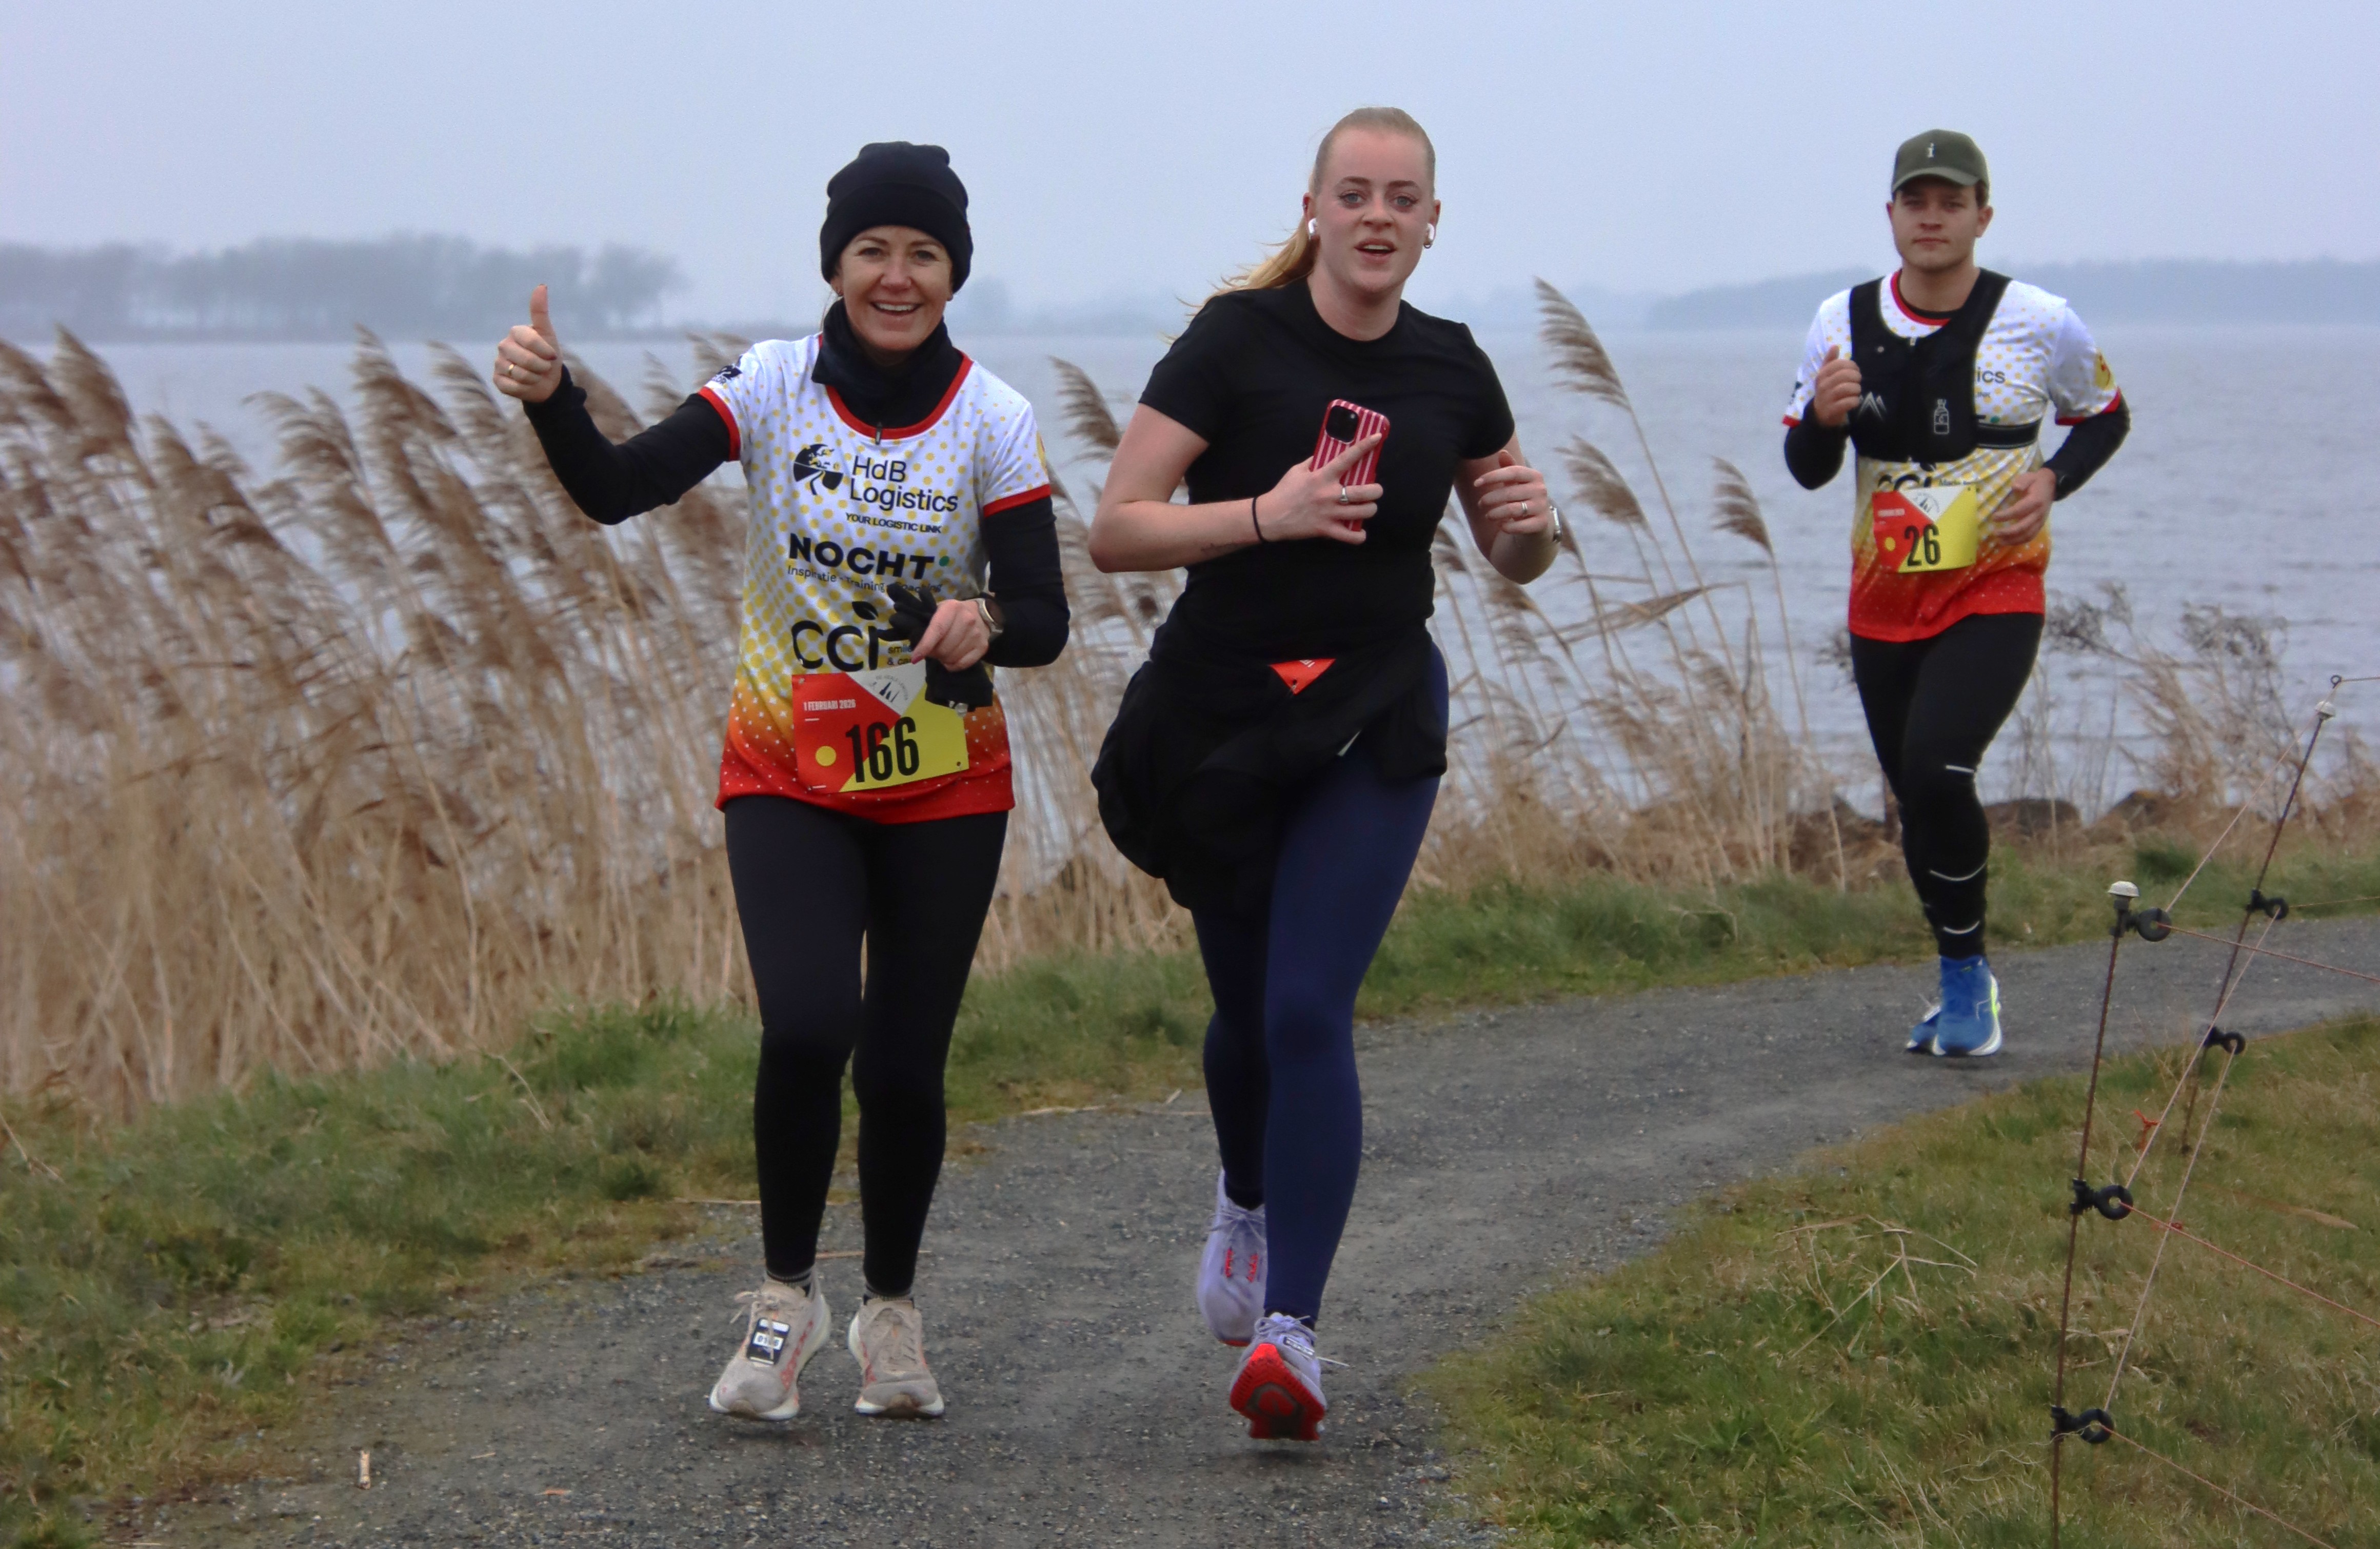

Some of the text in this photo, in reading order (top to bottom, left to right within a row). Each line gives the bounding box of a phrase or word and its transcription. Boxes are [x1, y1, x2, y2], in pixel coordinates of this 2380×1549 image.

[852, 455, 906, 483] HdB
[850, 478, 958, 512] Logistics
[846, 513, 942, 533] YOUR LOGISTIC LINK
[789, 533, 935, 580] NOCHT
[1904, 524, 1941, 566] 26
[803, 702, 807, 711] 1
[807, 700, 839, 711] FEBRUARI
[845, 716, 920, 783] 166
